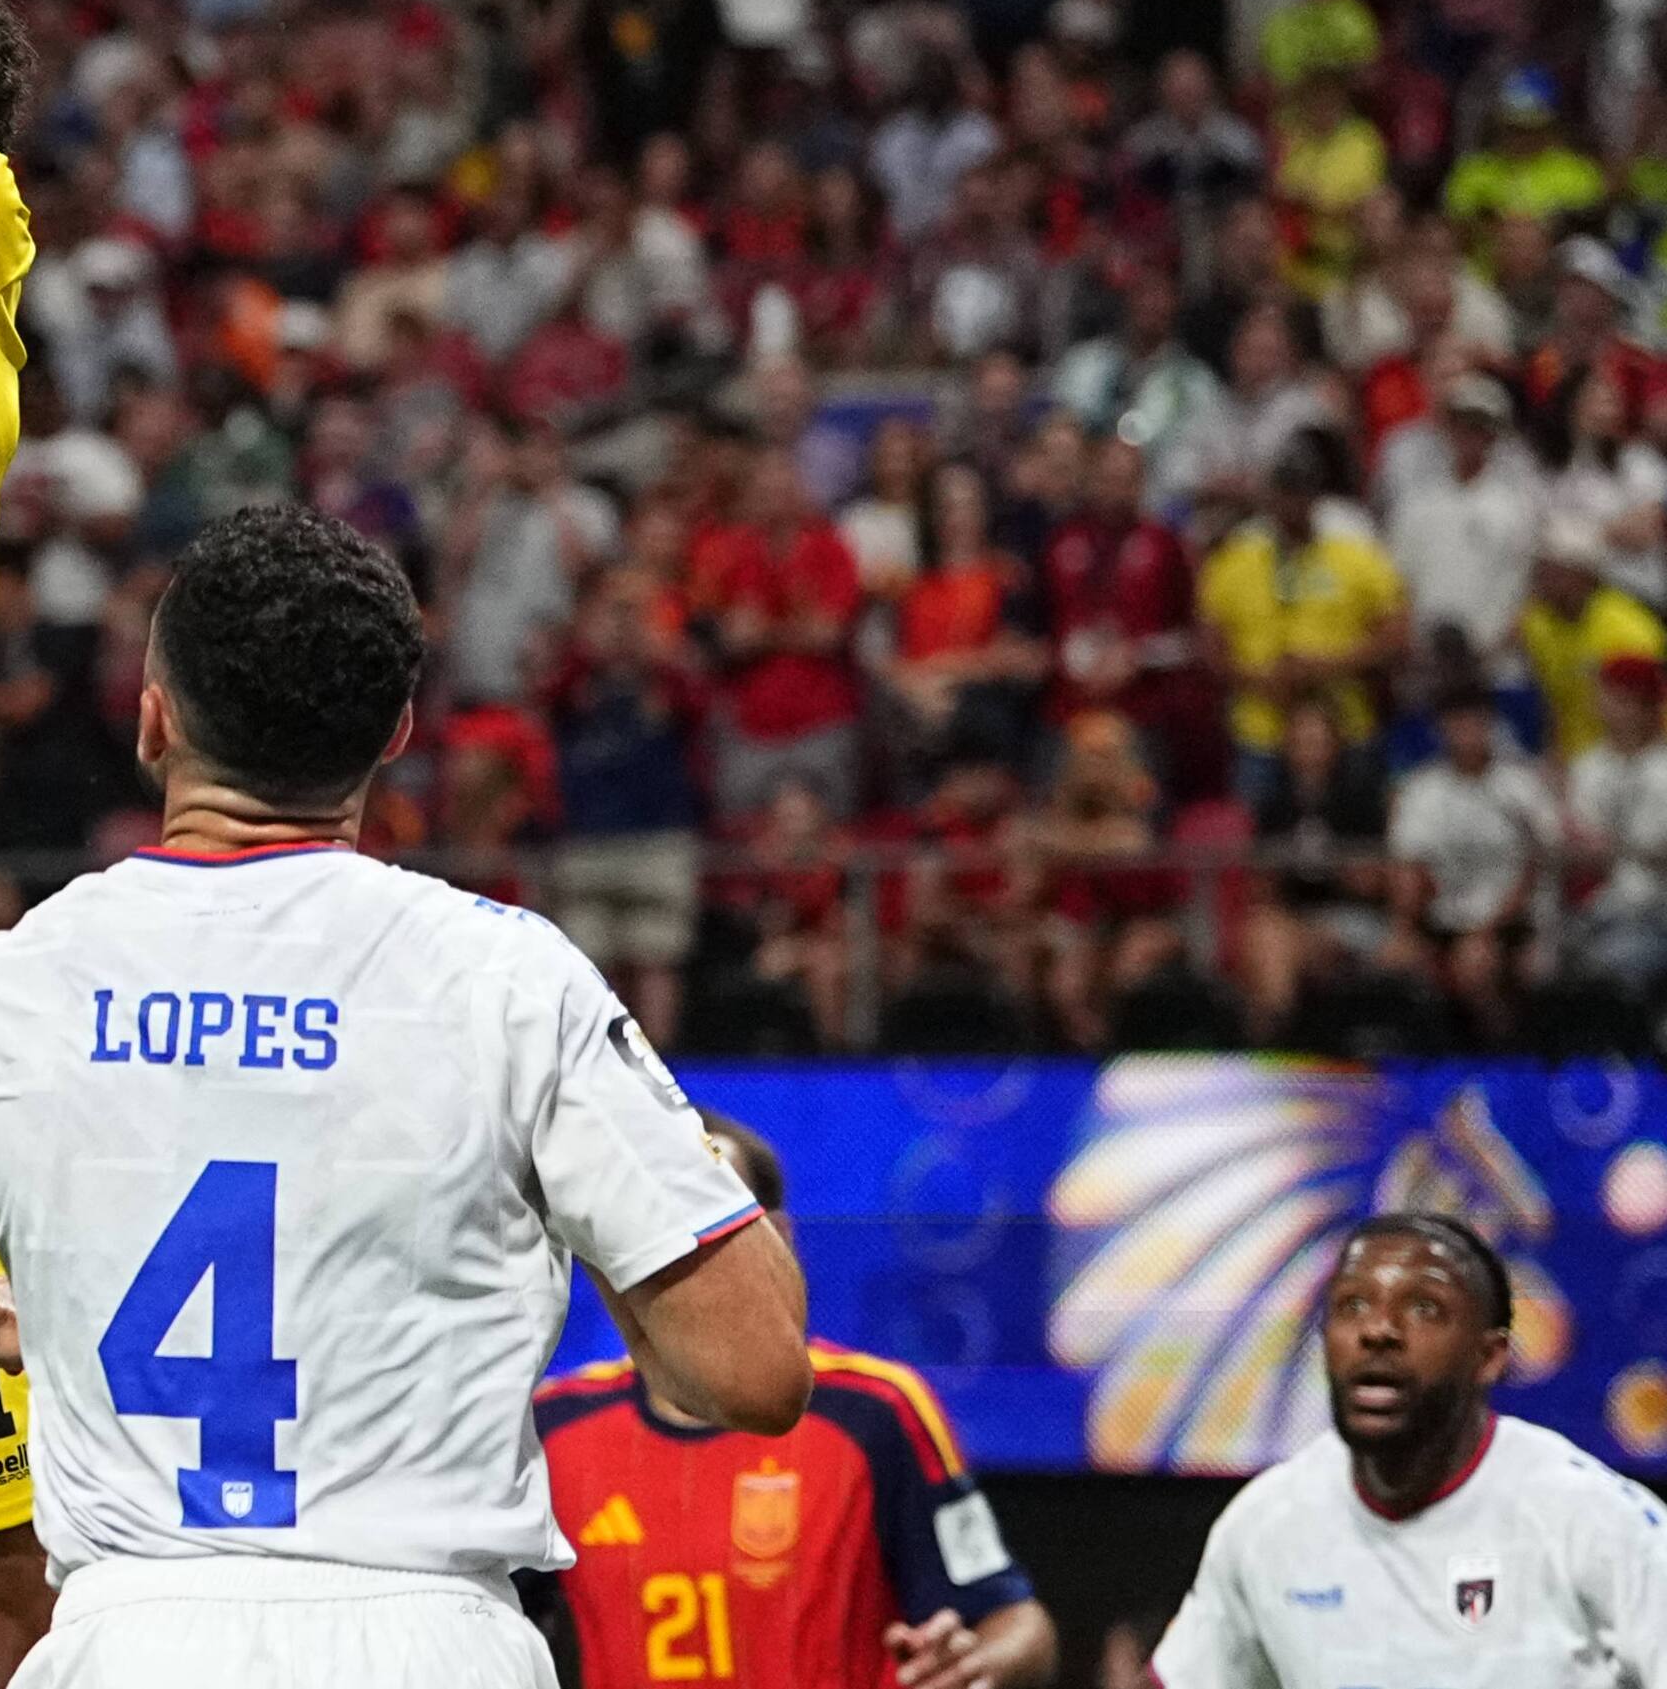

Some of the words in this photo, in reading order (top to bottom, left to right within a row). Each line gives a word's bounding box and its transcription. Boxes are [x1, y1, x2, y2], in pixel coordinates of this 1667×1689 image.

[90, 989, 339, 1070] LOPES
[98, 1160, 297, 1529] 4
[640, 1573, 734, 1681] 21
